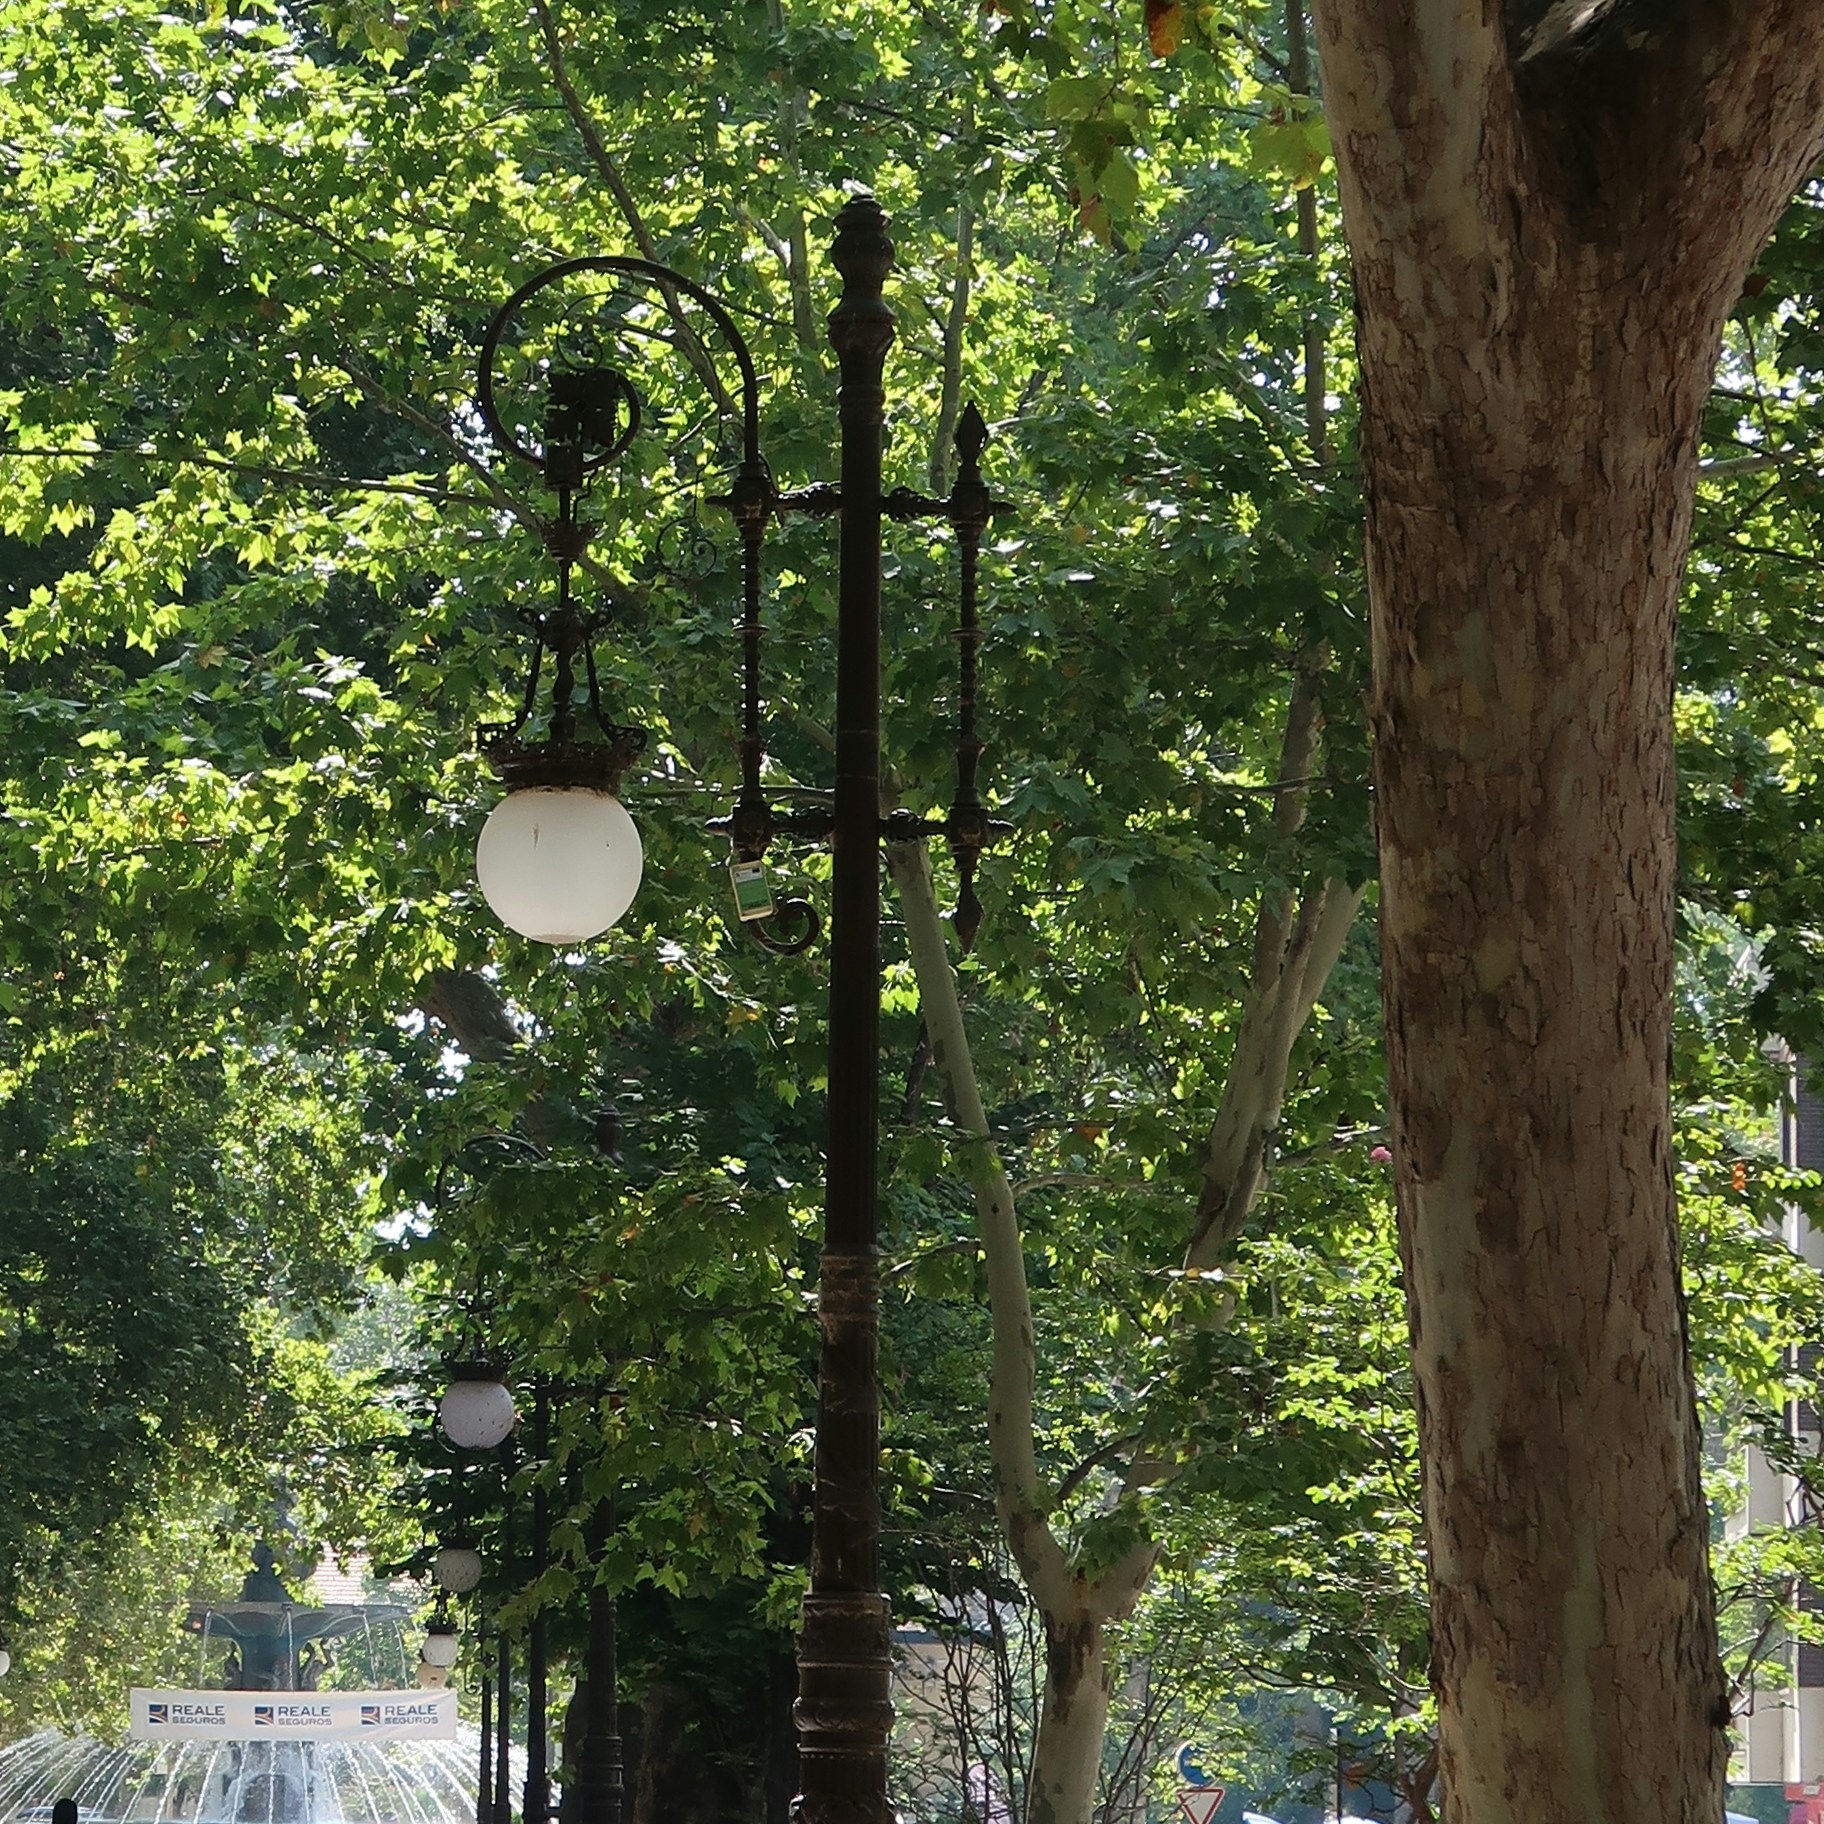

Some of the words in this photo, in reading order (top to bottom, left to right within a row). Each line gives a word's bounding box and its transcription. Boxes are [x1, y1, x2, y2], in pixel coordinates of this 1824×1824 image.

[172, 1704, 225, 1716] REALE
[278, 1706, 331, 1717] REALE
[384, 1704, 438, 1716] REALE
[172, 1716, 226, 1725] SEGUROS
[278, 1717, 332, 1726] SEGUROS
[384, 1716, 439, 1725] SEGUROS
